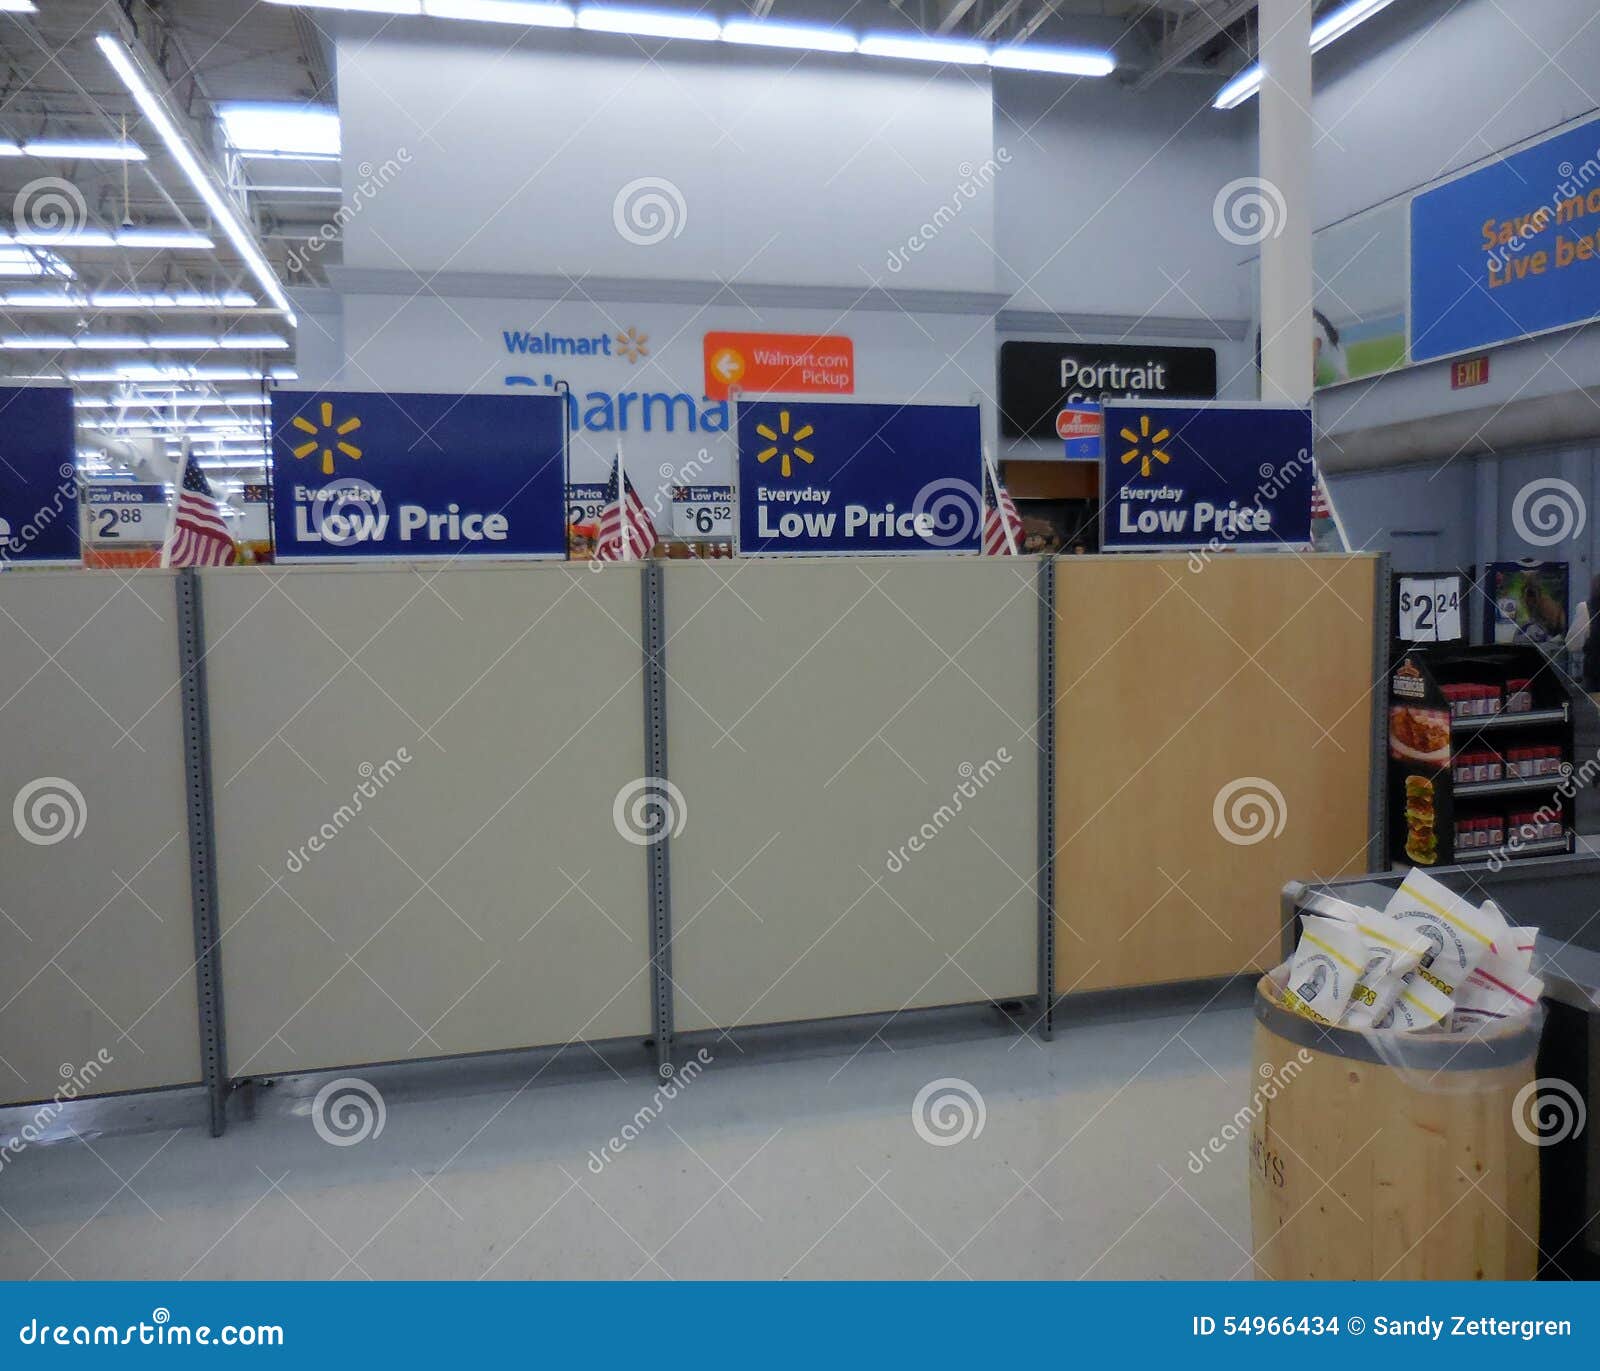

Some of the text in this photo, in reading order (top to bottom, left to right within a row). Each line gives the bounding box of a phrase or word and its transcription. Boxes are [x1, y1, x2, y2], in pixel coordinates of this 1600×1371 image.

[503, 331, 611, 356] Walmart
[753, 350, 849, 369] Walmart.com
[802, 369, 849, 389] Pickup
[1060, 359, 1166, 390] Portrait
[1457, 359, 1481, 386] EXIT
[113, 491, 144, 502] Price
[294, 485, 383, 506] Everyday
[577, 489, 602, 499] Price
[690, 489, 711, 500] Low
[757, 486, 831, 505] Everyday
[1120, 486, 1184, 503] Everyday
[295, 503, 509, 542] Low Price
[757, 503, 935, 538] Low Price
[1119, 501, 1272, 534] Low Price
